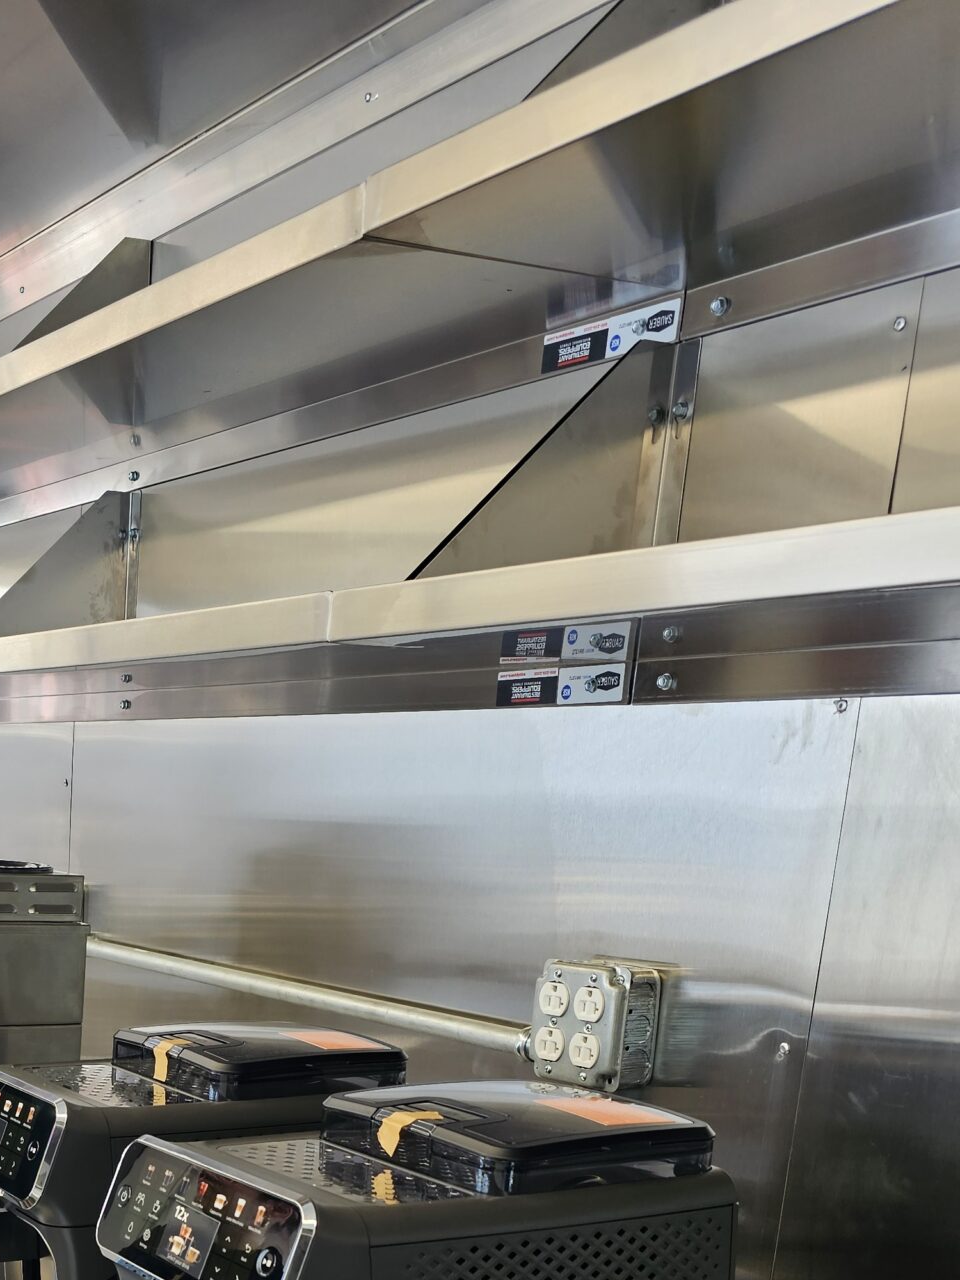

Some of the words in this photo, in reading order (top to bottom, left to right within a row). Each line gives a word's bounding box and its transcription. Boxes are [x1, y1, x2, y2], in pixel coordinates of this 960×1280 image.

[648, 313, 673, 330] SAUBER
[558, 341, 591, 356] EQUIPPERS
[558, 349, 589, 362] RESTAURANT
[512, 685, 542, 693] EQUIPPERS
[512, 691, 541, 699] RESTAURANT
[174, 1205, 190, 1222] 12x
